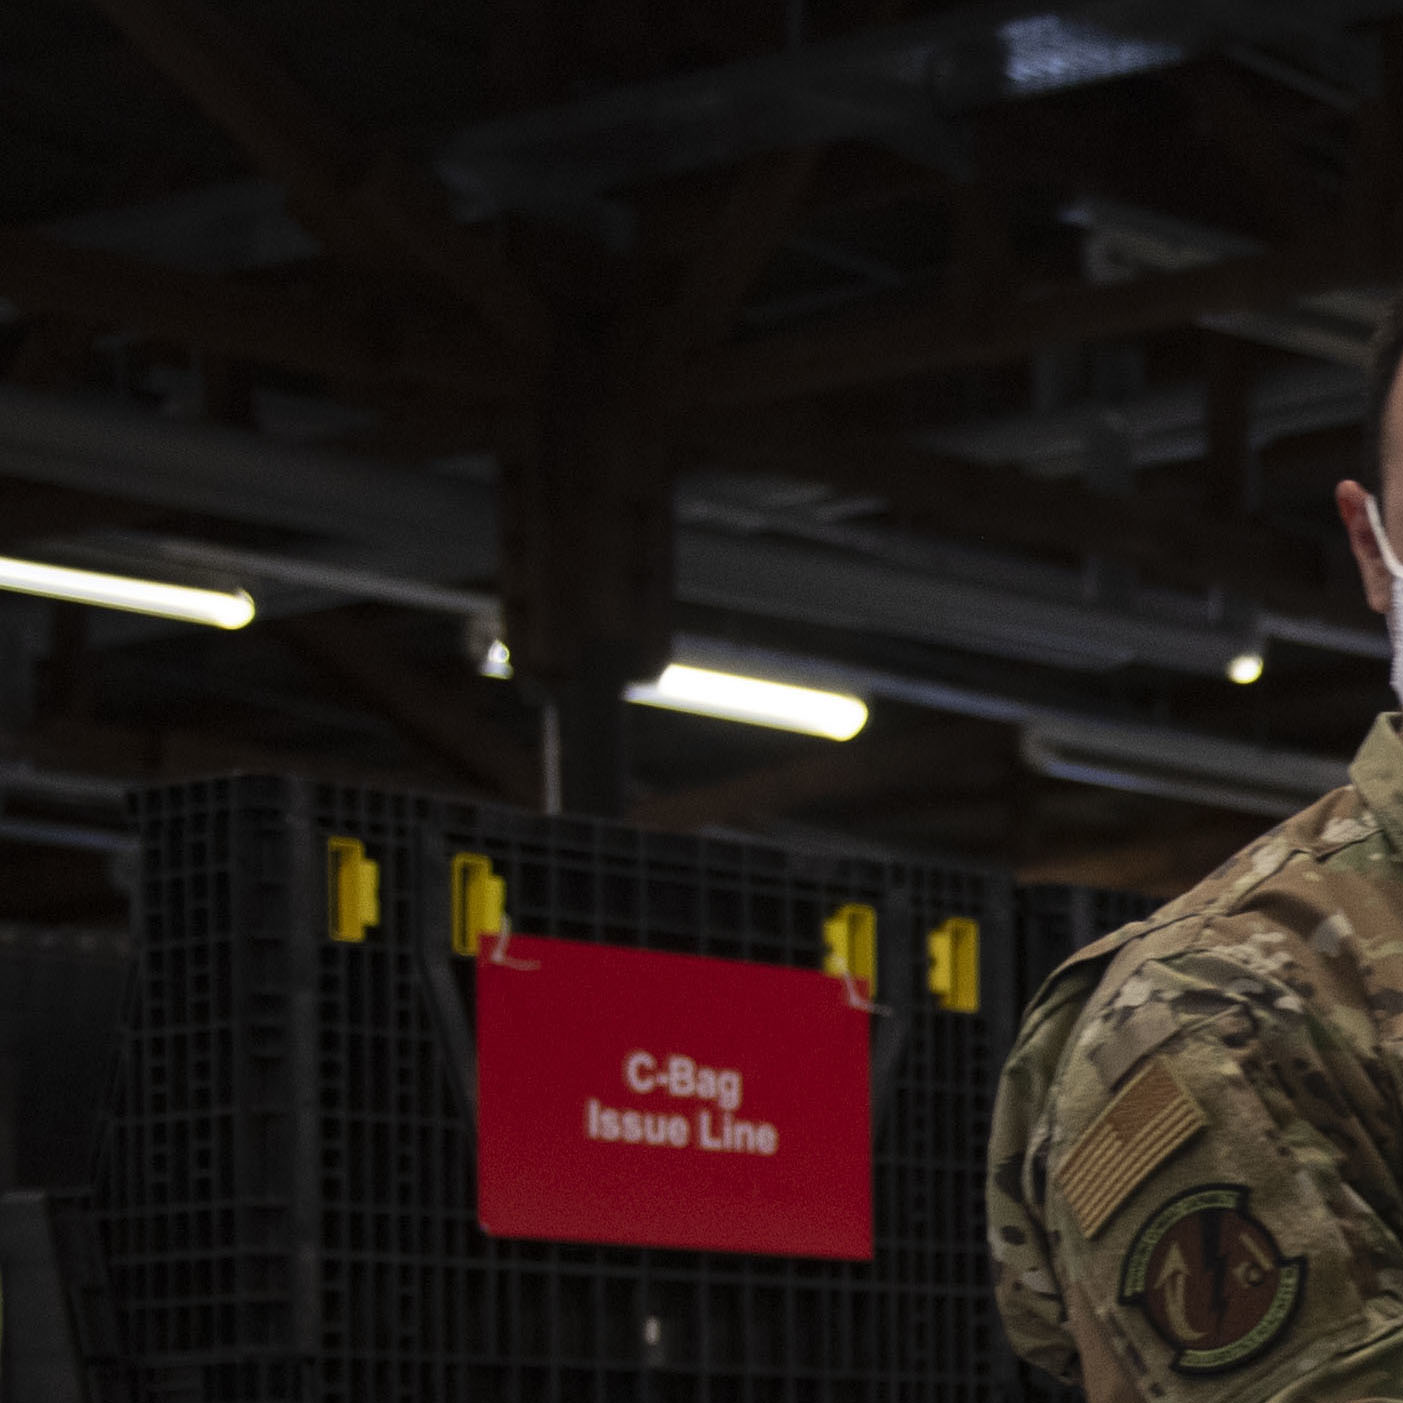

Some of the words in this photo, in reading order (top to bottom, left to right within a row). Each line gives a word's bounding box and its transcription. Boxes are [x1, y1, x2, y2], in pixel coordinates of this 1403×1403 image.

[625, 1049, 743, 1110] C-Bag
[586, 1098, 690, 1149] Issue
[700, 1109, 779, 1156] Line
